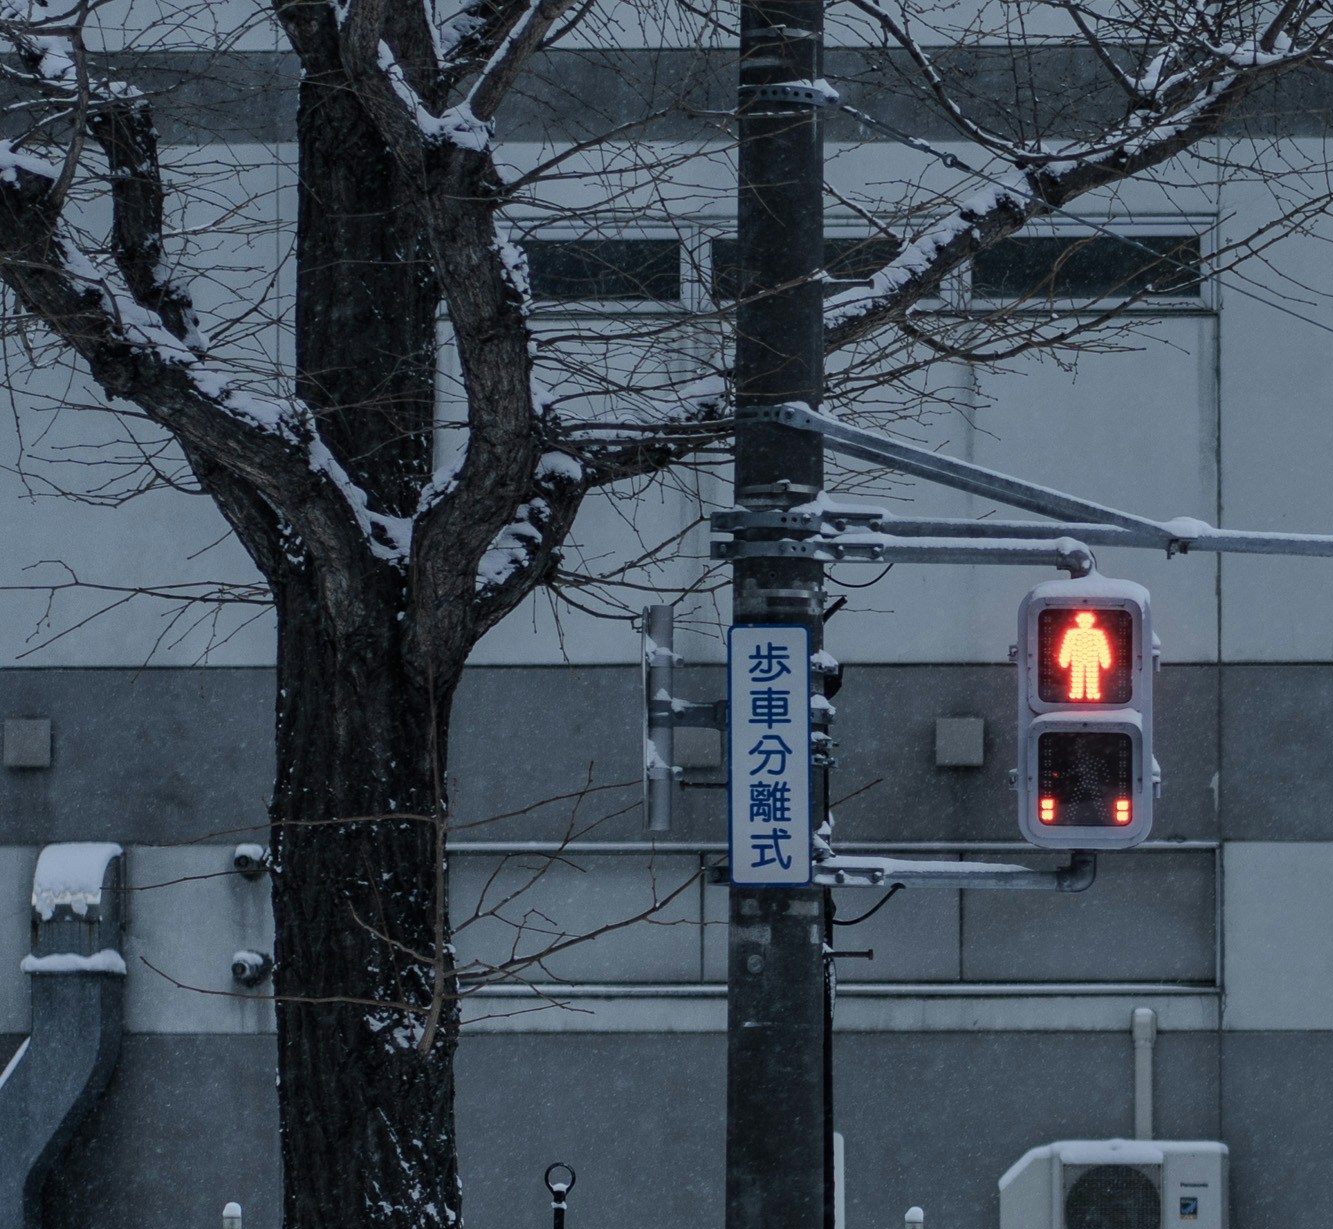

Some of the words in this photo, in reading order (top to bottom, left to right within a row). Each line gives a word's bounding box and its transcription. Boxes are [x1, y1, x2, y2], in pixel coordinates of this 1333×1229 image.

[749, 642, 793, 870] 歩車分離式
